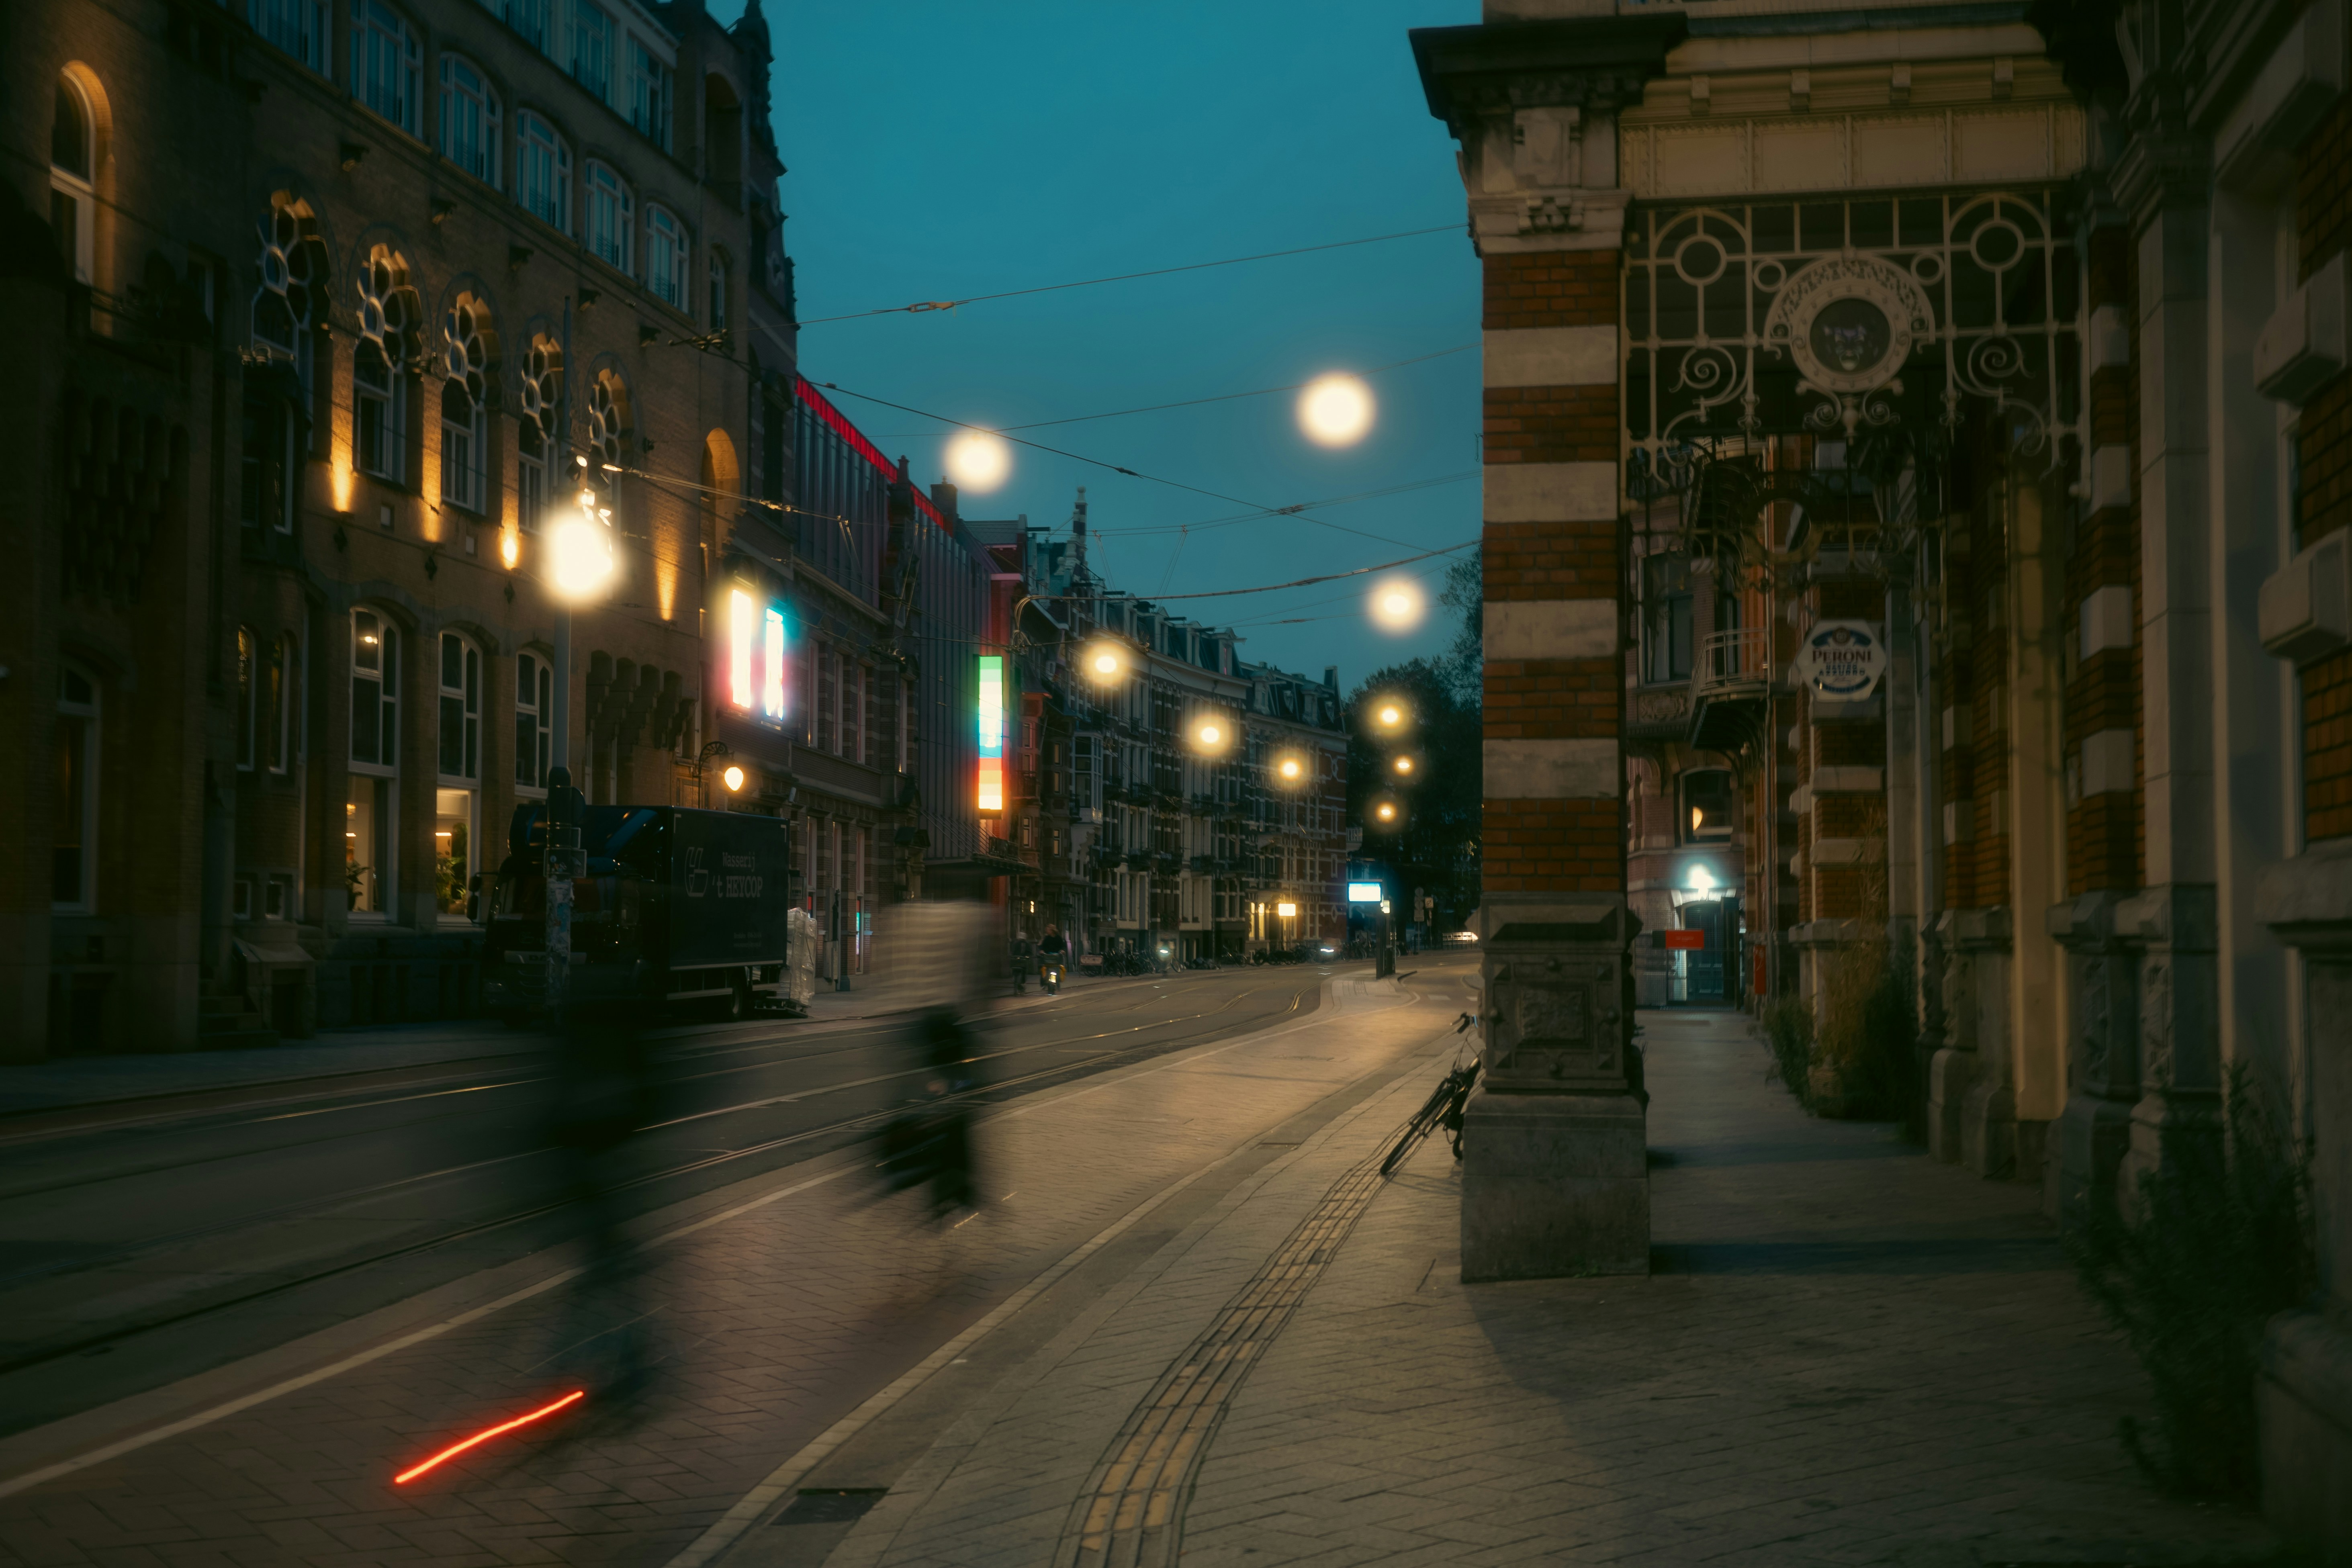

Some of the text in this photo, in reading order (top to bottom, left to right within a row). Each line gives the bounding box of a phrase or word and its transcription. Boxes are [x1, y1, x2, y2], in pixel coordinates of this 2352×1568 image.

[1813, 650, 1871, 663] PERONI
[722, 851, 755, 873] Wasserij
[726, 875, 763, 898] HEYCOP
